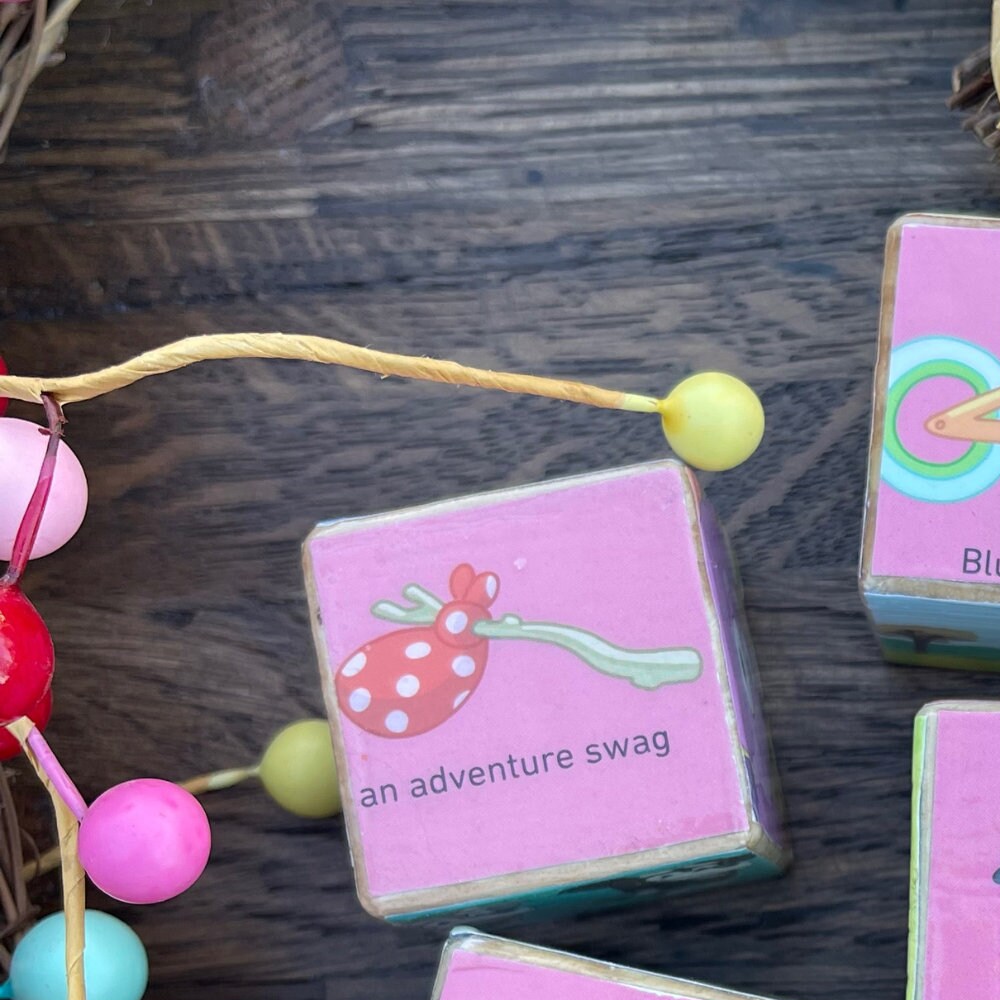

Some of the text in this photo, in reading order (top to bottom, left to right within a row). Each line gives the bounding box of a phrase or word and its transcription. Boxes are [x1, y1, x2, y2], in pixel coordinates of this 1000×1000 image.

[360, 730, 670, 808] an adventure swag
